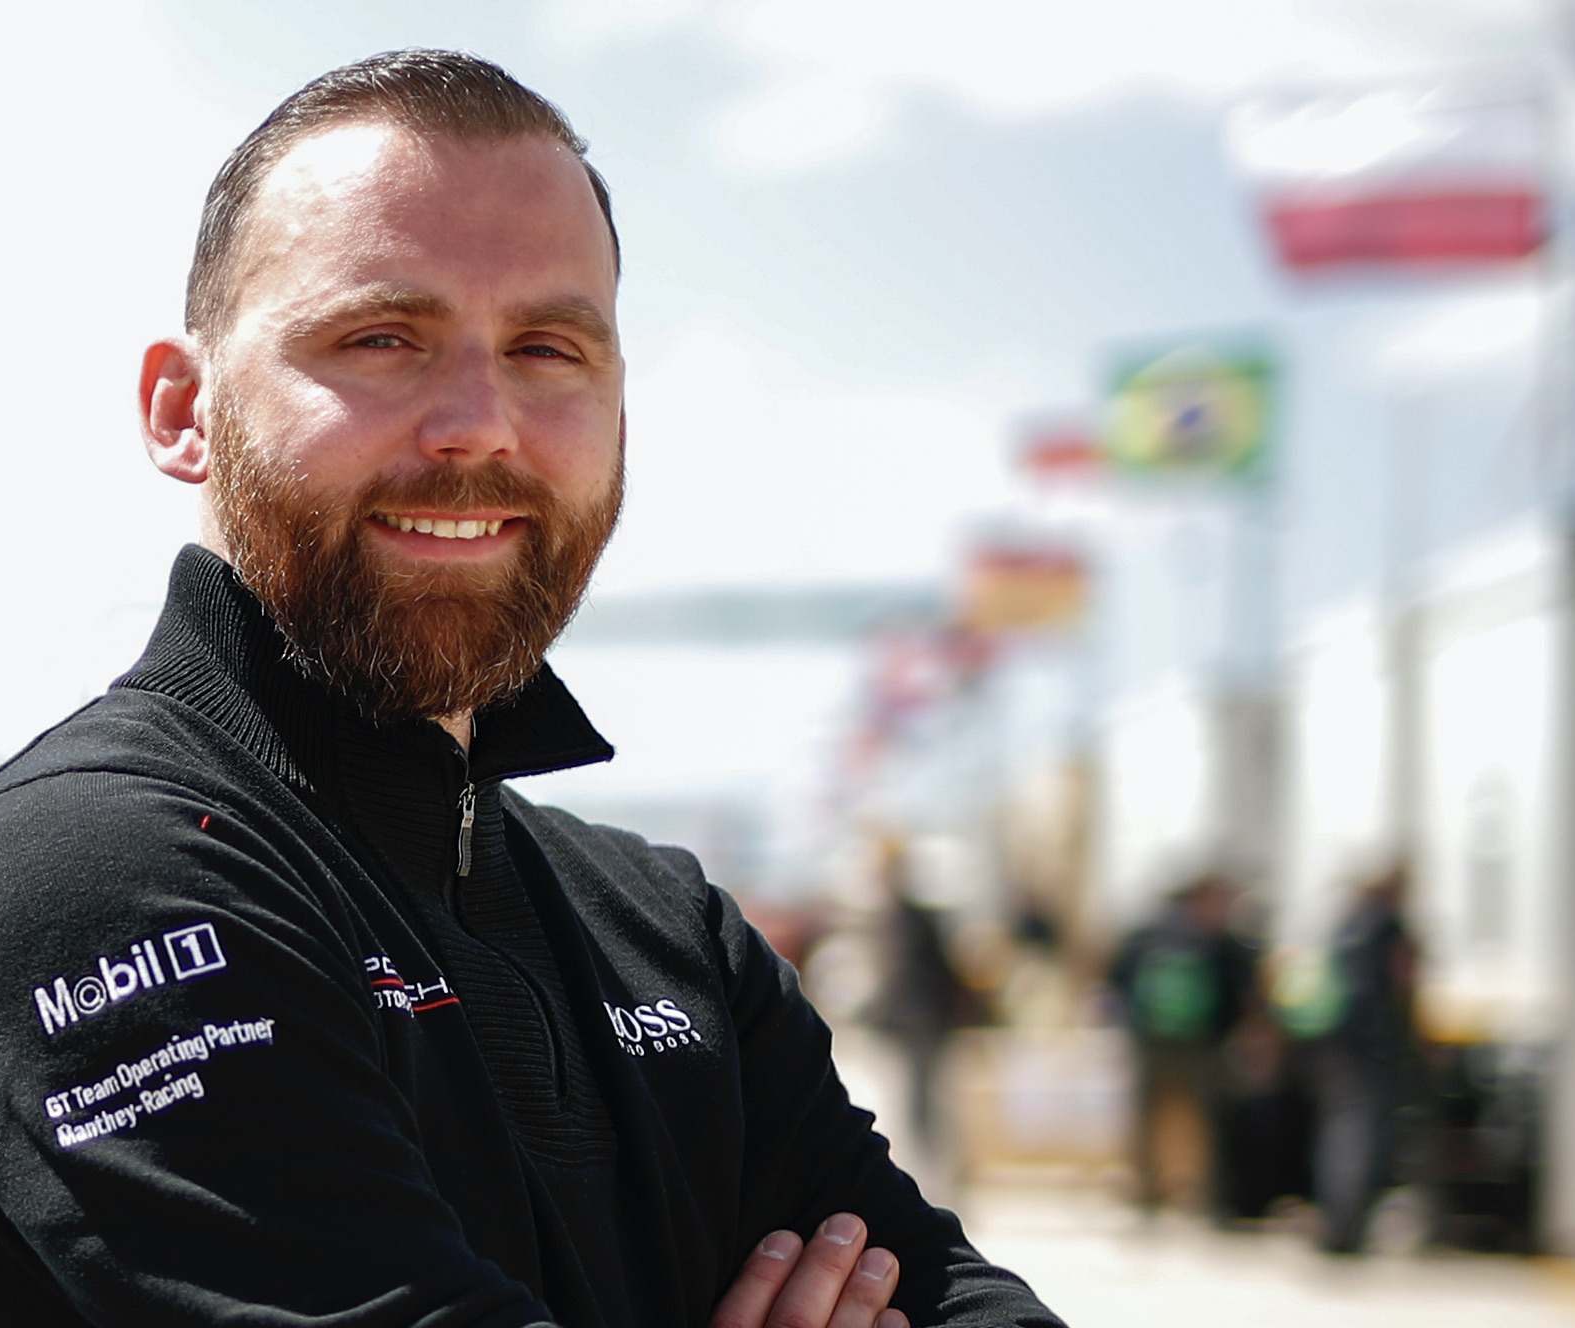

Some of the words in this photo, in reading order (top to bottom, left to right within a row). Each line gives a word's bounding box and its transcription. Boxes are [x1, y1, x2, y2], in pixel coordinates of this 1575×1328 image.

[34, 939, 166, 1035] Mobil
[45, 1092, 72, 1119] GT
[70, 1076, 121, 1108] Team
[116, 1034, 210, 1088] Operating
[203, 1017, 275, 1049] Partner
[56, 1072, 205, 1148] Manthey-Racing
